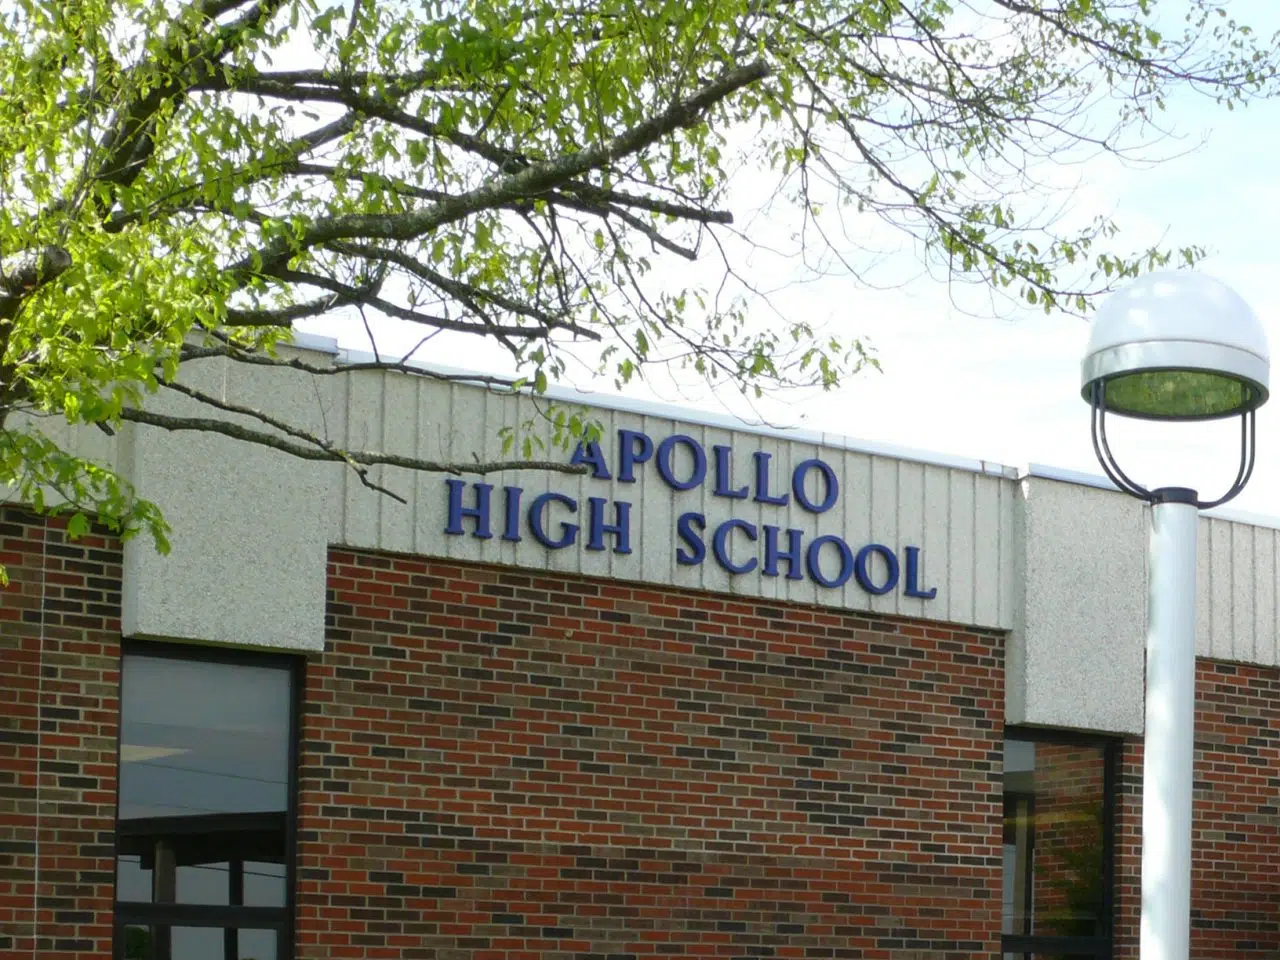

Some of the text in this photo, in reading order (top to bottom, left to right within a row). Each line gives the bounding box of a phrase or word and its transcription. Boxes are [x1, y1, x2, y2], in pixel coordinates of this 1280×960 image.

[569, 426, 839, 514] APOLLO
[444, 479, 938, 599] HIGH SCHOOL
